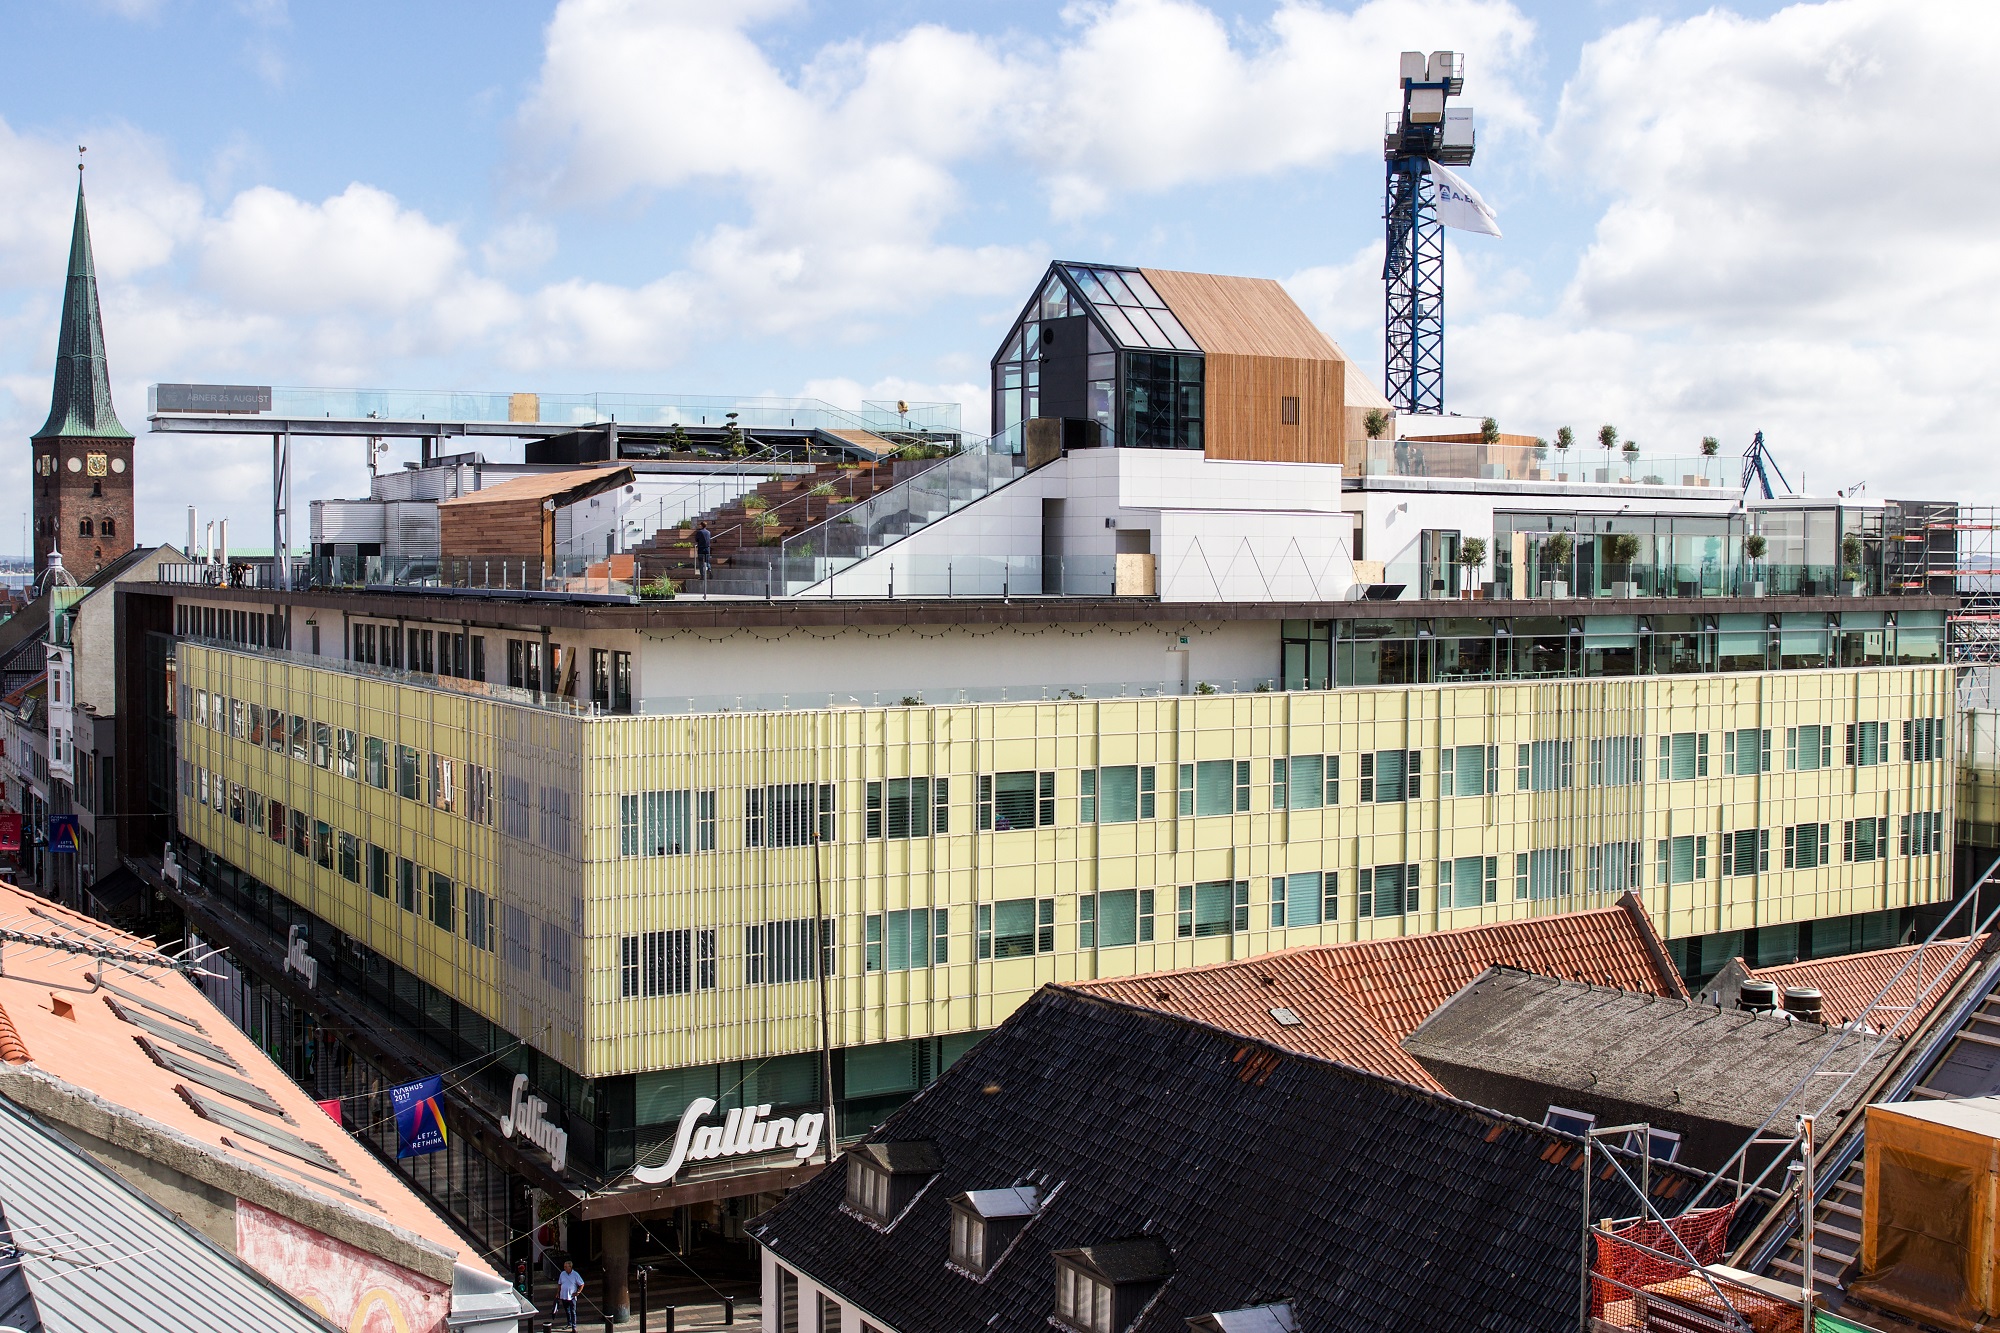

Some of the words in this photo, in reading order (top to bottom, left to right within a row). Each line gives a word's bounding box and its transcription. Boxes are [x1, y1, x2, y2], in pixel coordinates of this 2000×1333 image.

[233, 394, 269, 402] AUGUST
[393, 1082, 424, 1096] AARHUS
[394, 1092, 410, 1102] 2017
[500, 1073, 567, 1172] Salling
[417, 1130, 438, 1140] LET'S
[632, 1097, 824, 1184] Salling
[412, 1137, 442, 1149] RETHINK
